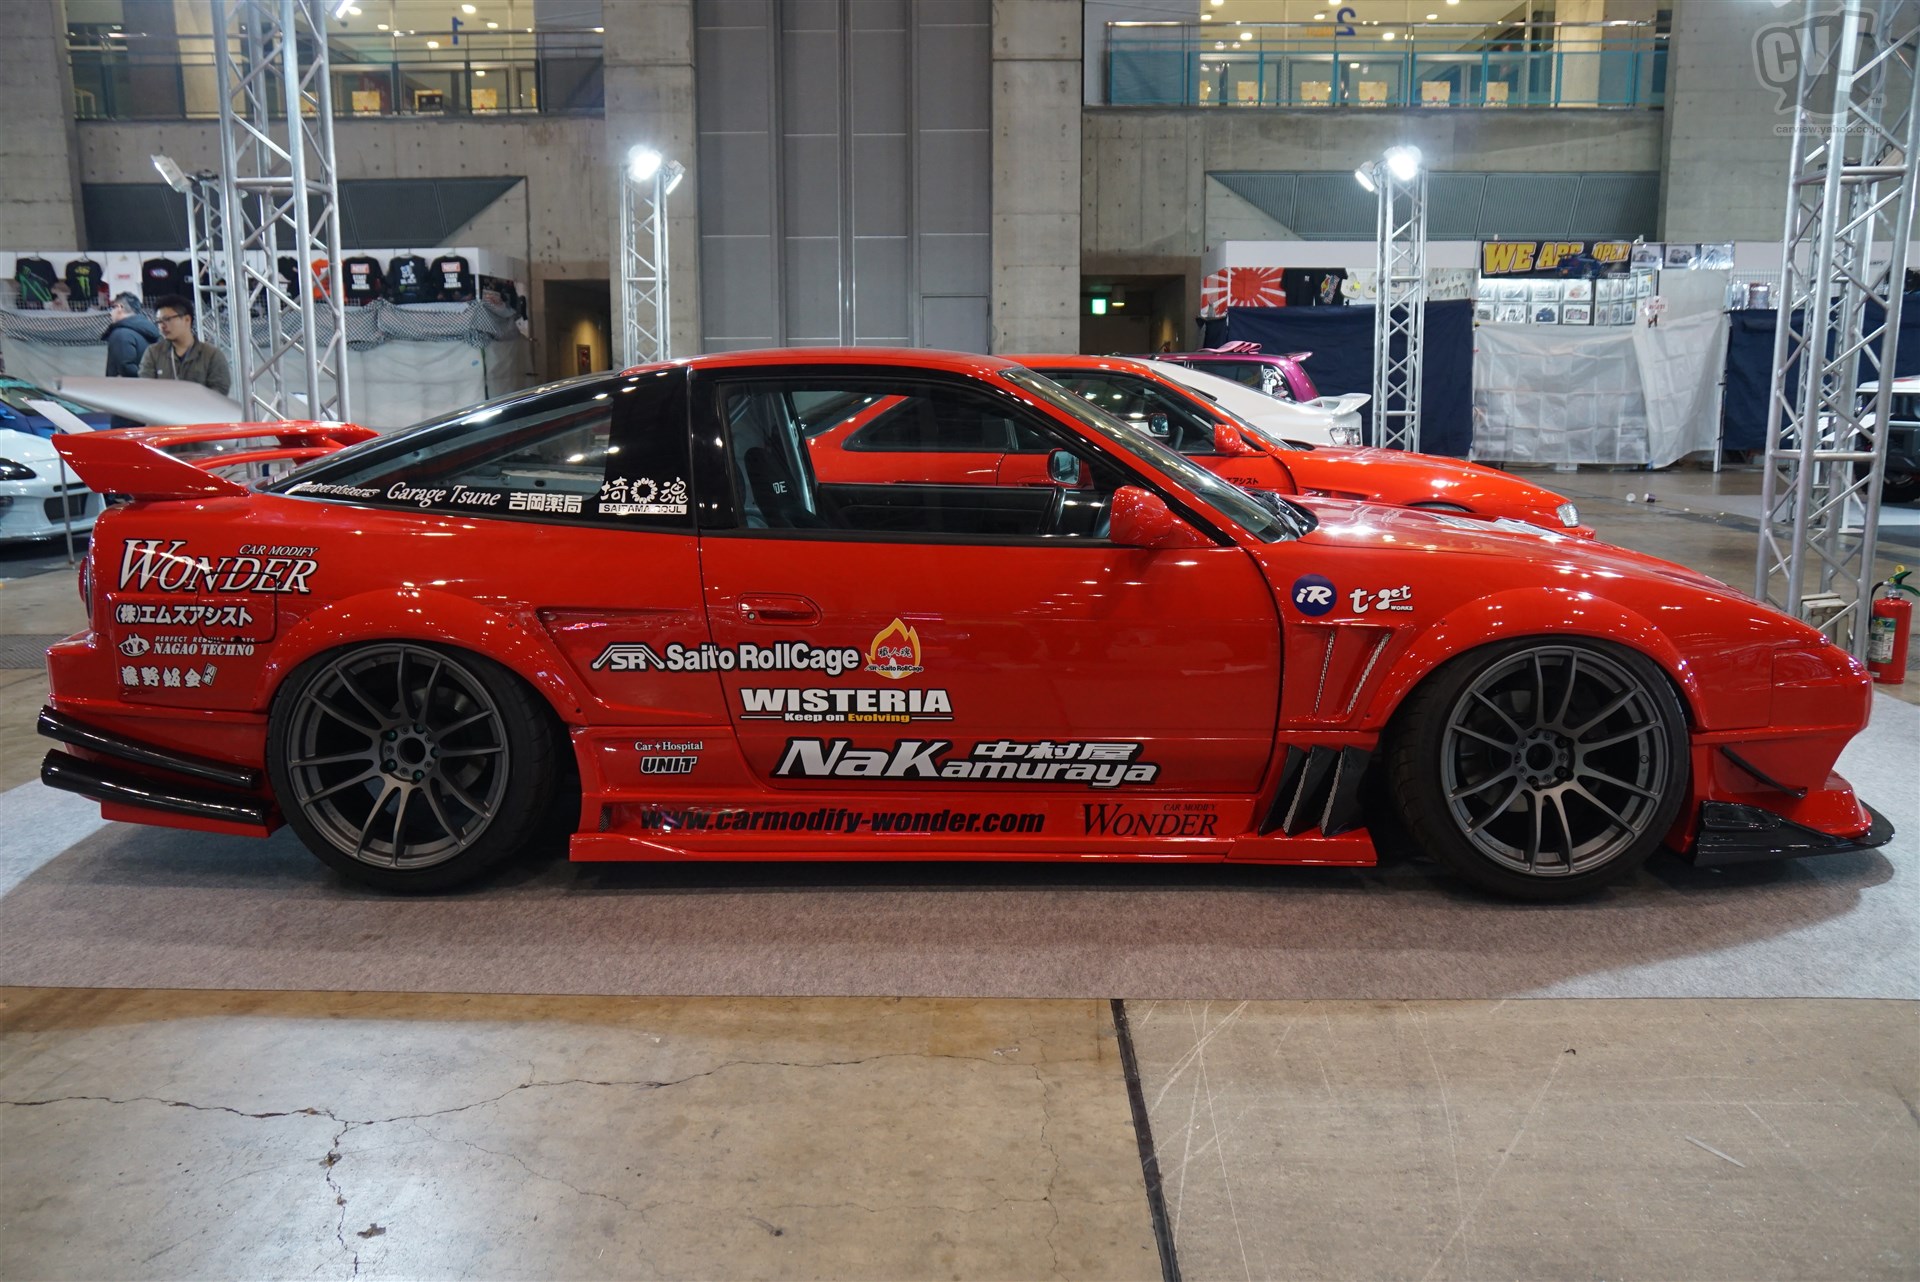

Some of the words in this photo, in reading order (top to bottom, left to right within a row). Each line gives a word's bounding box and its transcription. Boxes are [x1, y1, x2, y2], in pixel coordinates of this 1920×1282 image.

[1484, 242, 1536, 274] WE
[386, 482, 447, 507] Garage
[451, 485, 501, 508] Tsune
[509, 492, 583, 513] 吉岡薬局
[239, 545, 266, 555] CAR
[268, 546, 318, 557] MODIFY
[118, 539, 318, 594] WONDER
[153, 643, 198, 655] NAGAO
[201, 644, 255, 656] TECHNO
[667, 644, 733, 671] Saito
[740, 643, 860, 676] RollCage
[741, 689, 952, 712] WISTERIA
[784, 713, 823, 722] Keep
[826, 714, 845, 722] on
[848, 713, 910, 723] Evolving
[634, 741, 652, 750] Car
[662, 741, 703, 752] Hospital
[973, 742, 1138, 762] 中村屋
[641, 757, 697, 773] UNIT
[1163, 804, 1180, 812] CAR
[1183, 804, 1216, 812] MODIFY
[641, 808, 1046, 834] www.carmodify-wonder.com
[1083, 804, 1219, 836] WONDER
